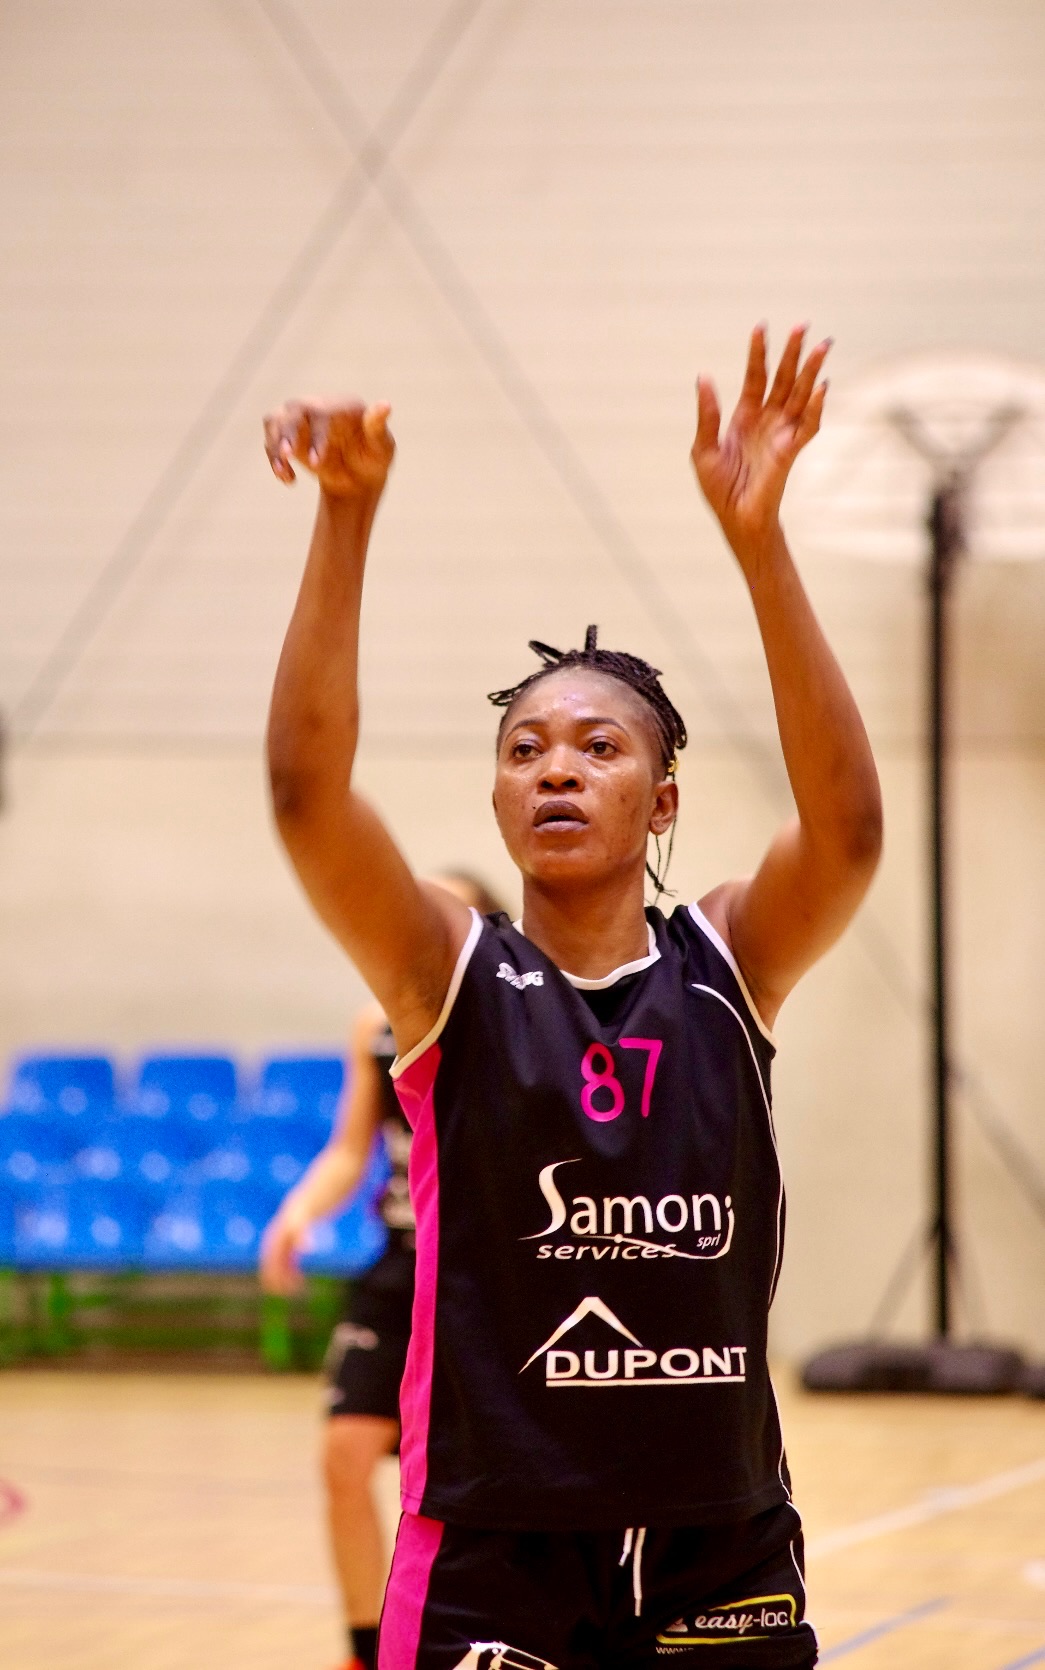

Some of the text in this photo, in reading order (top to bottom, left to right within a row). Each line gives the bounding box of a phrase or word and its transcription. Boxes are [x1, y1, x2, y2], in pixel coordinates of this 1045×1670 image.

[580, 1037, 663, 1123] 87
[536, 1233, 721, 1260] services sprl
[545, 1346, 748, 1380] DUPONT
